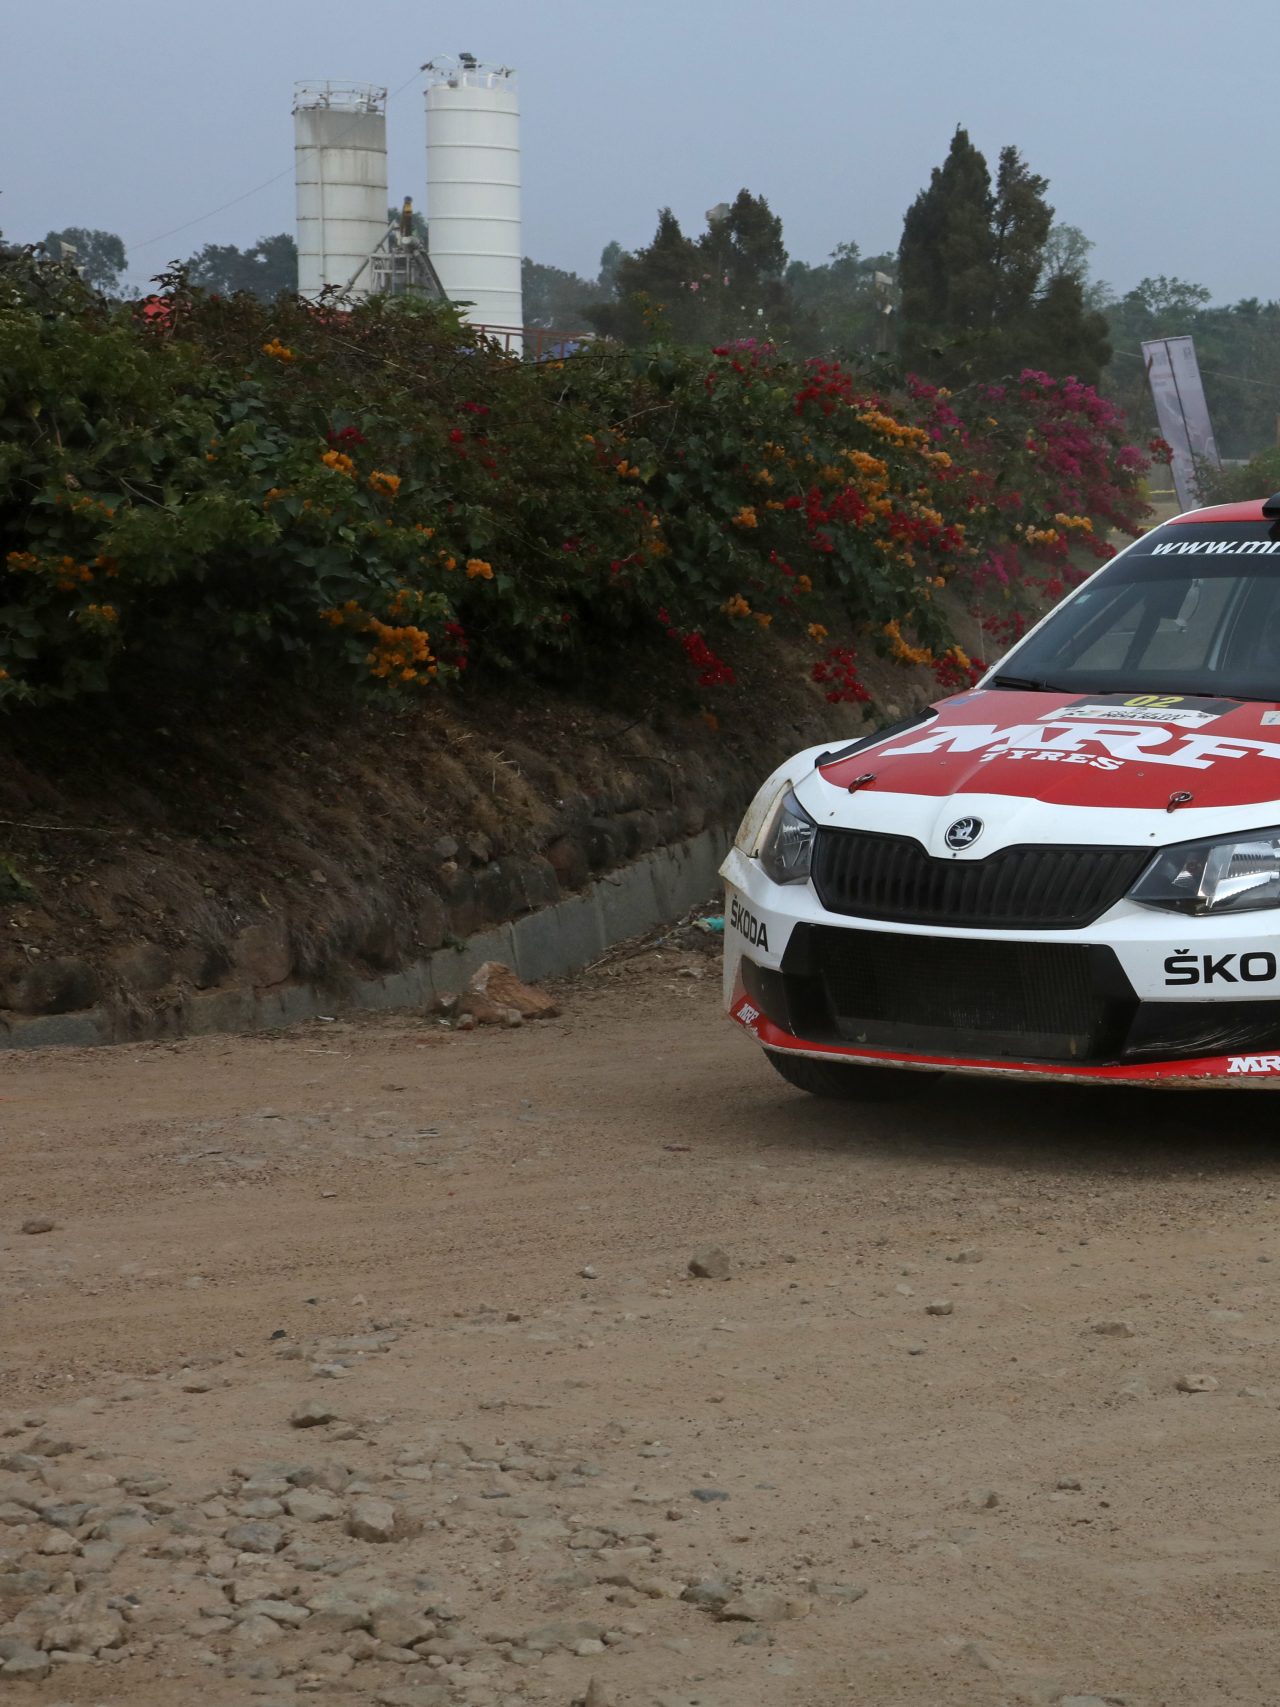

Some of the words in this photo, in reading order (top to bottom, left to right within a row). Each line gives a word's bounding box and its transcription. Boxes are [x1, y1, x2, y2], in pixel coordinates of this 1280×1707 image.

[1123, 695, 1185, 708] 02
[979, 749, 1126, 771] TYRES
[730, 896, 769, 952] ŠKODA
